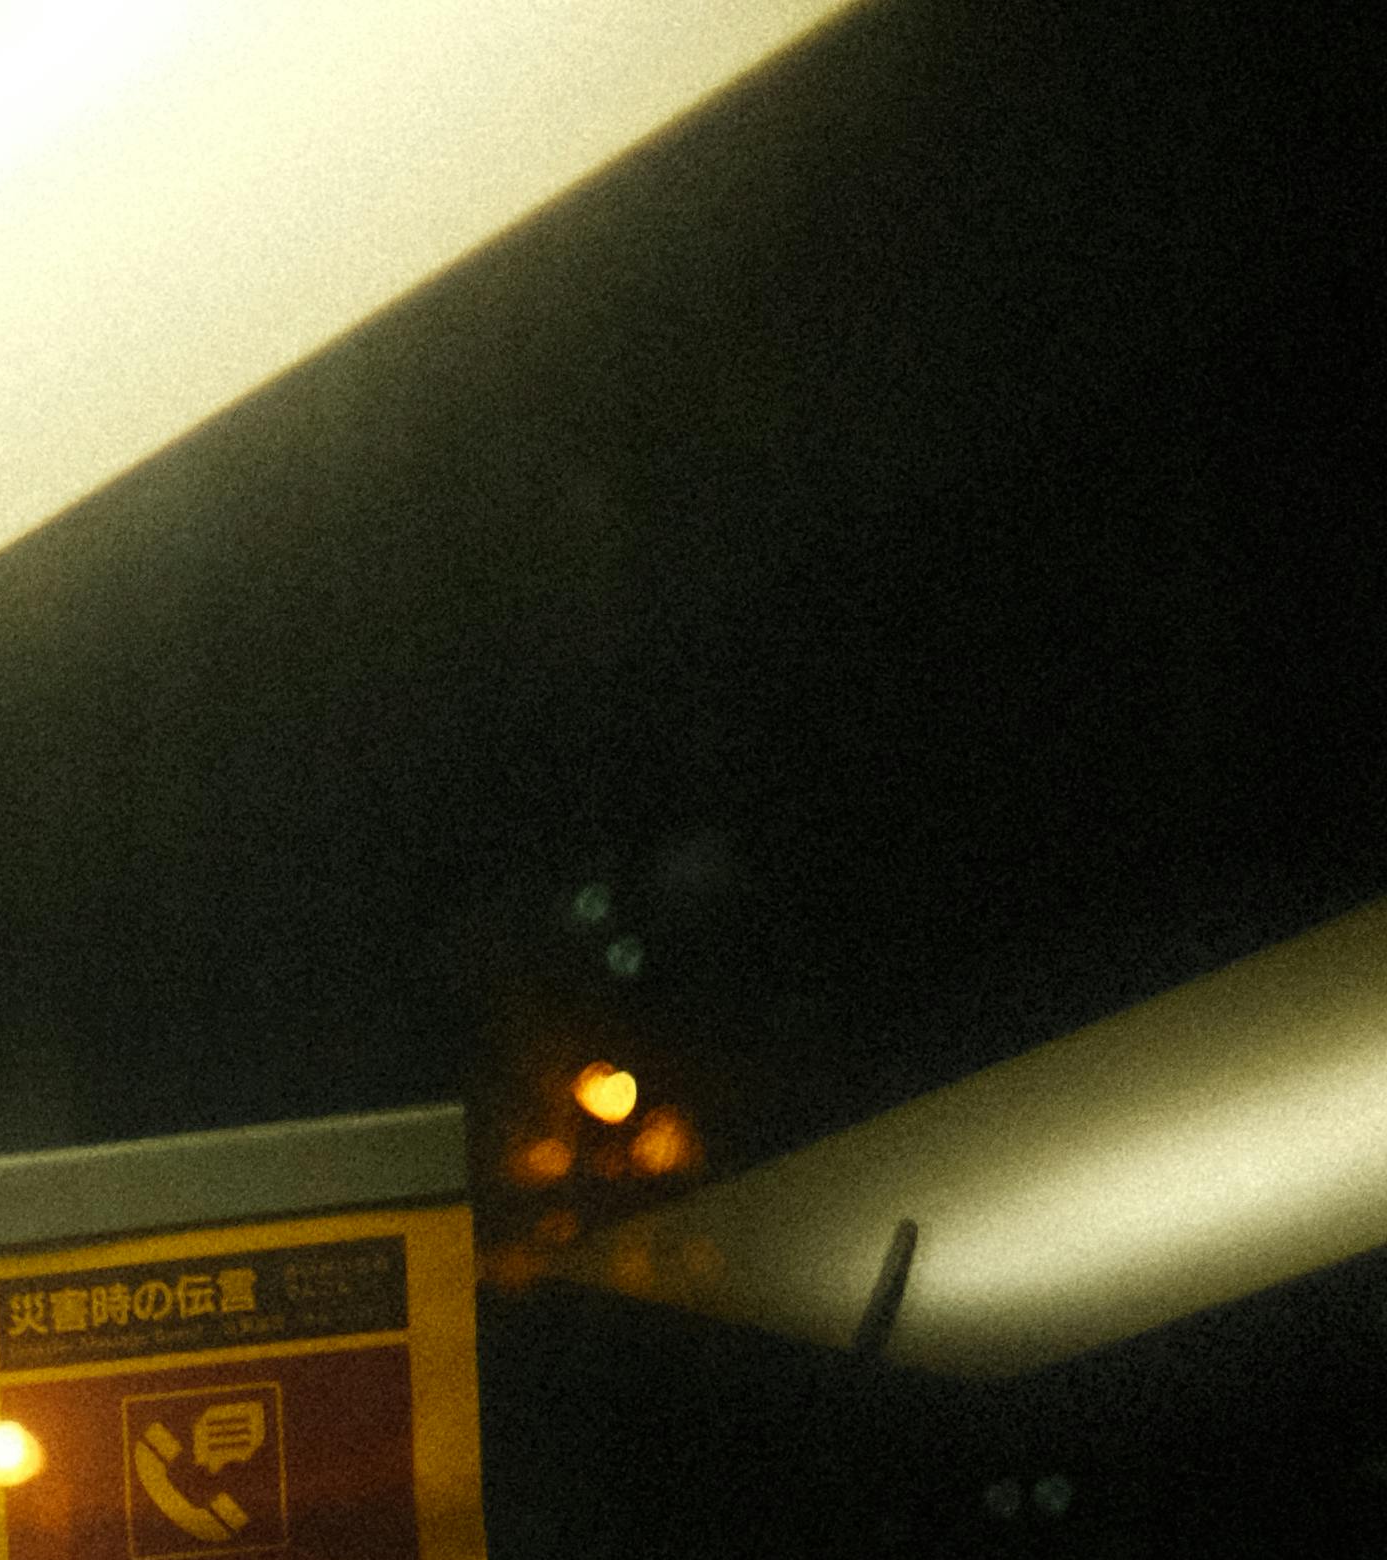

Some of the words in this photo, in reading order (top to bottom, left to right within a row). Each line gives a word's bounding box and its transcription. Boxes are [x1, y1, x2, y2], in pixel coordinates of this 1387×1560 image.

[9, 1268, 259, 1337] 災害時の伝言
